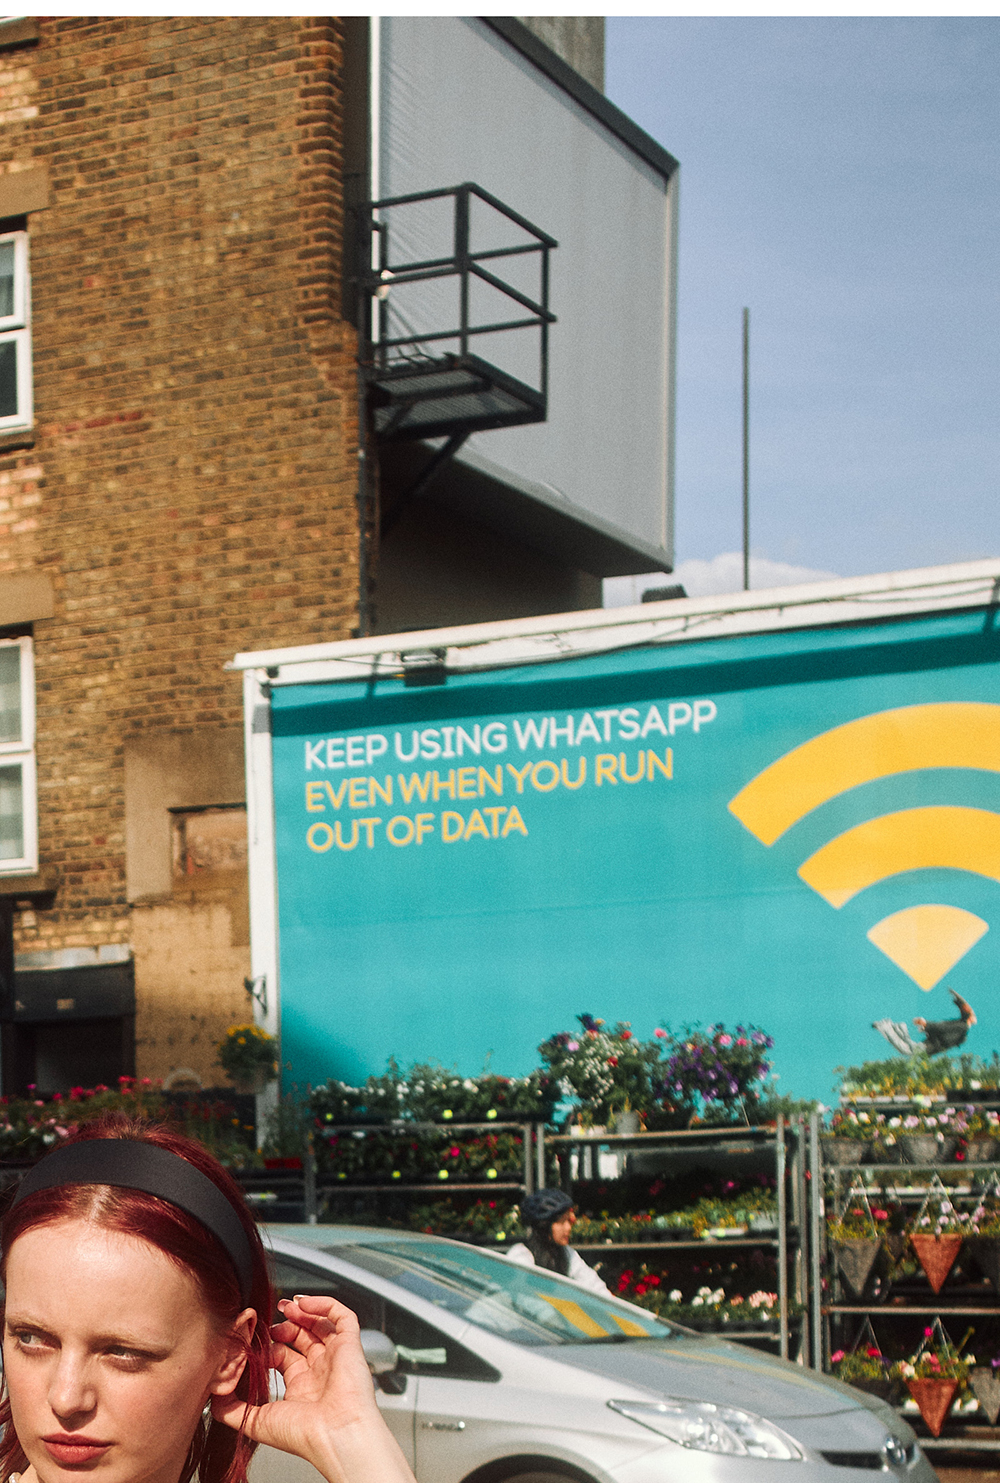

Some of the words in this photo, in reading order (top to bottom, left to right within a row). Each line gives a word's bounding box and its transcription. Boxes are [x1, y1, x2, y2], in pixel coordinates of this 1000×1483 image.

[305, 733, 389, 770] KEEP
[394, 721, 508, 762] USING
[513, 699, 718, 751] WHATSAPP
[305, 774, 393, 813] EVEN
[397, 764, 503, 804] WHEN
[506, 755, 587, 794] YOU
[595, 747, 674, 787] RUN
[306, 817, 382, 853] OUT
[386, 813, 435, 847] OF
[441, 805, 529, 844] DATA
